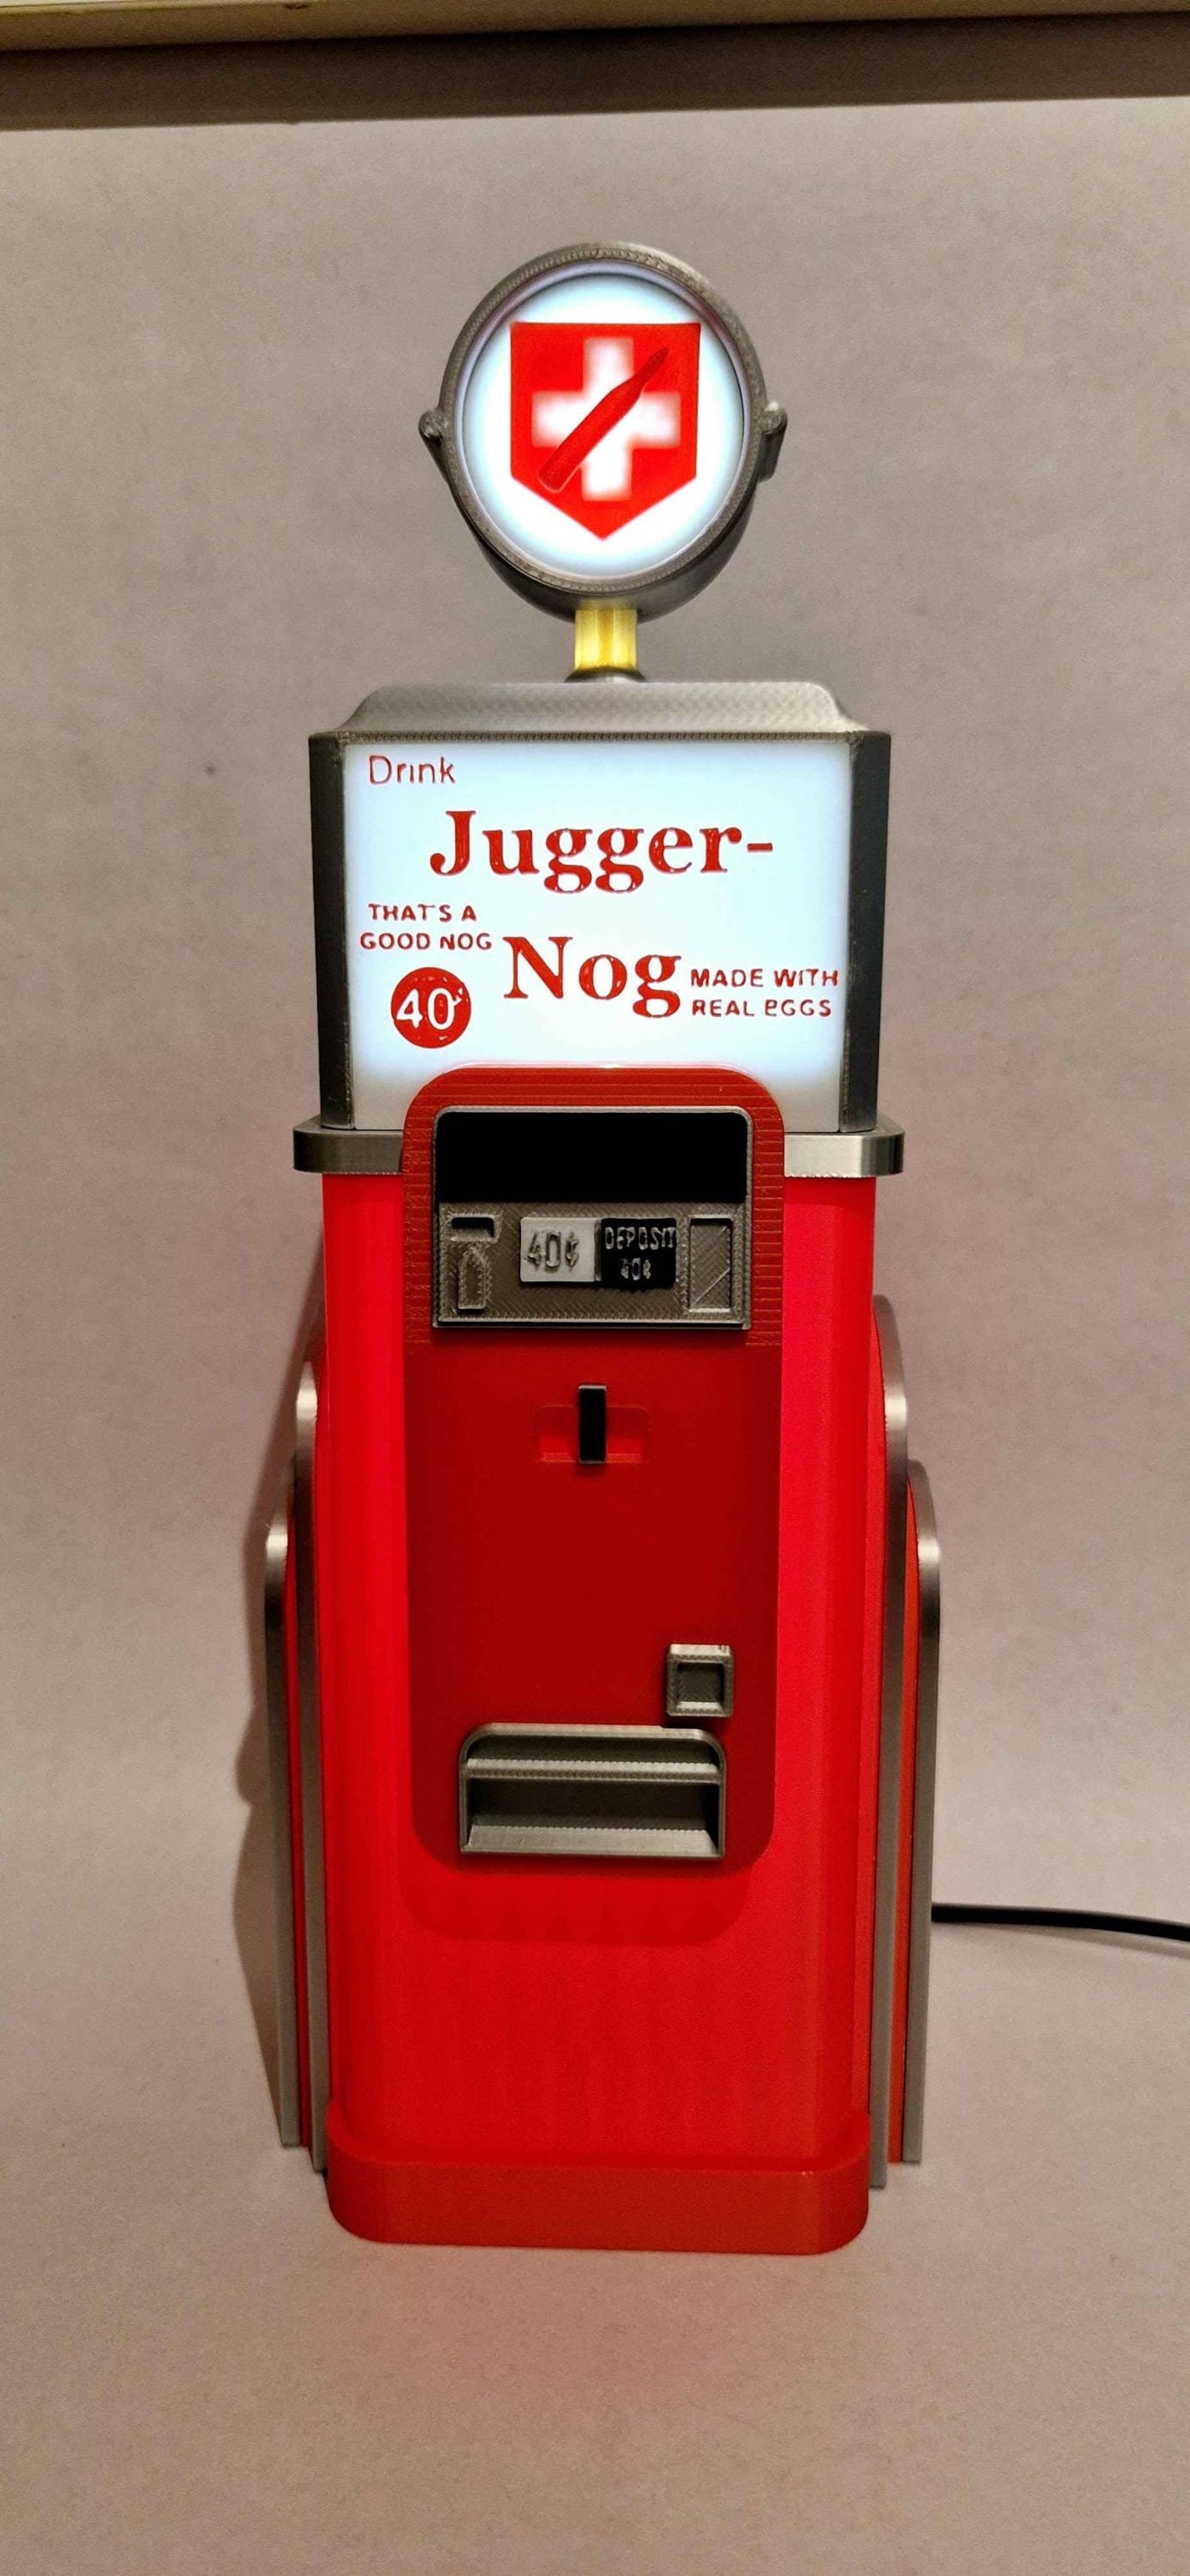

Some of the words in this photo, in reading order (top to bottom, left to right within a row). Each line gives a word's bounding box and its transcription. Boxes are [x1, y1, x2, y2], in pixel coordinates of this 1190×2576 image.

[369, 755, 456, 785] Drink
[429, 810, 773, 893] Jugger-
[461, 904, 477, 922] A
[360, 932, 430, 950] GOOD
[439, 932, 492, 951] NOG
[503, 936, 681, 1018] Nog
[690, 968, 763, 987] MADE
[773, 968, 839, 986] WITH
[692, 999, 754, 1017] REAL
[764, 999, 832, 1018] EGGS
[604, 1226, 674, 1250] DEPOSIT
